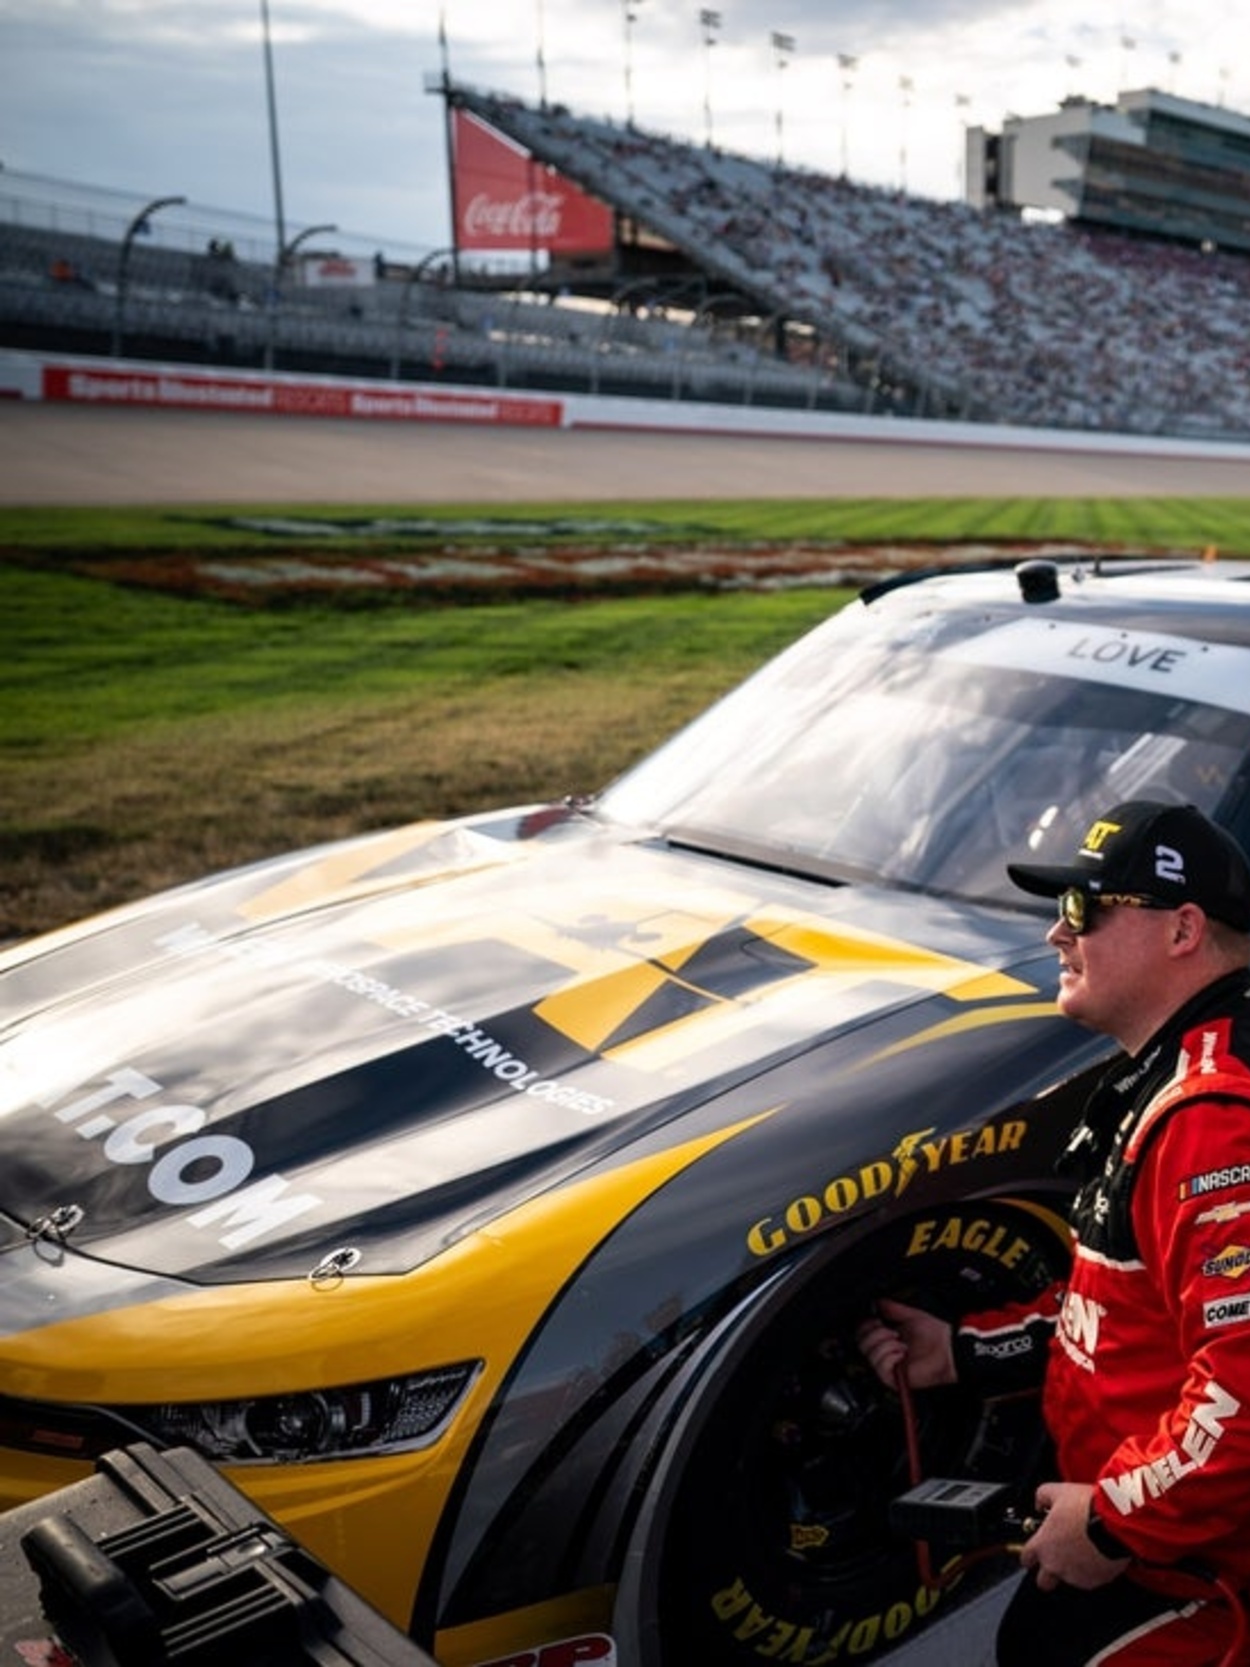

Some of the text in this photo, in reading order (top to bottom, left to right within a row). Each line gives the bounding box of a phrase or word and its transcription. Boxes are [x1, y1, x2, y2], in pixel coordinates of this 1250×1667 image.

[463, 191, 563, 237] Coca-Cola
[1066, 636, 1188, 674] LOVE
[1155, 844, 1186, 882] 2
[418, 1006, 614, 1116] TECHNOLOGIES
[747, 1119, 1028, 1257] GOODYEAR
[905, 1217, 1030, 1270] EAGLE
